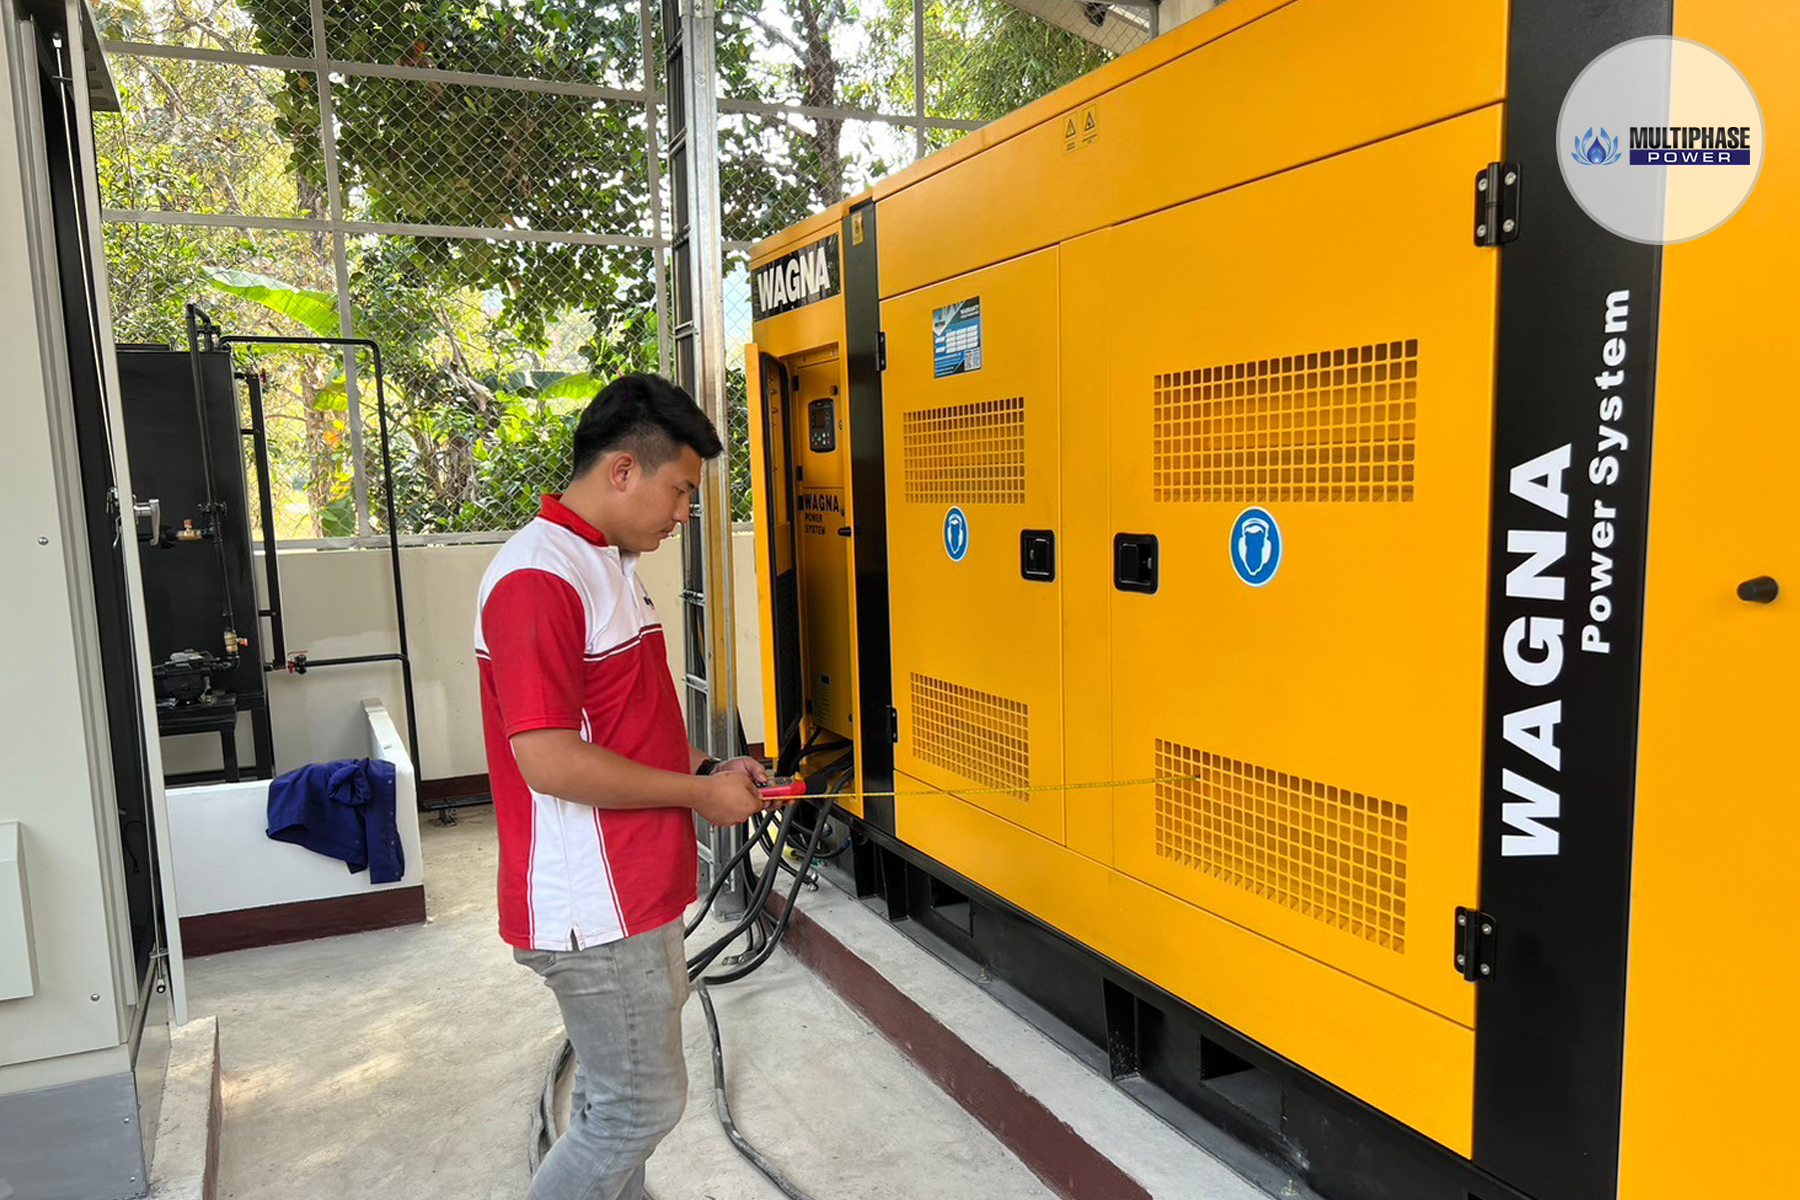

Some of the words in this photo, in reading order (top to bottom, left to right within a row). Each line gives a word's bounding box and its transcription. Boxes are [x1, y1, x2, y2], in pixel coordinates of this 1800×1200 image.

[757, 247, 830, 312] WAGNA
[1589, 288, 1631, 487] System
[804, 494, 839, 512] WAGNA
[1581, 500, 1617, 654] Power
[1501, 442, 1573, 858] WAGNA
